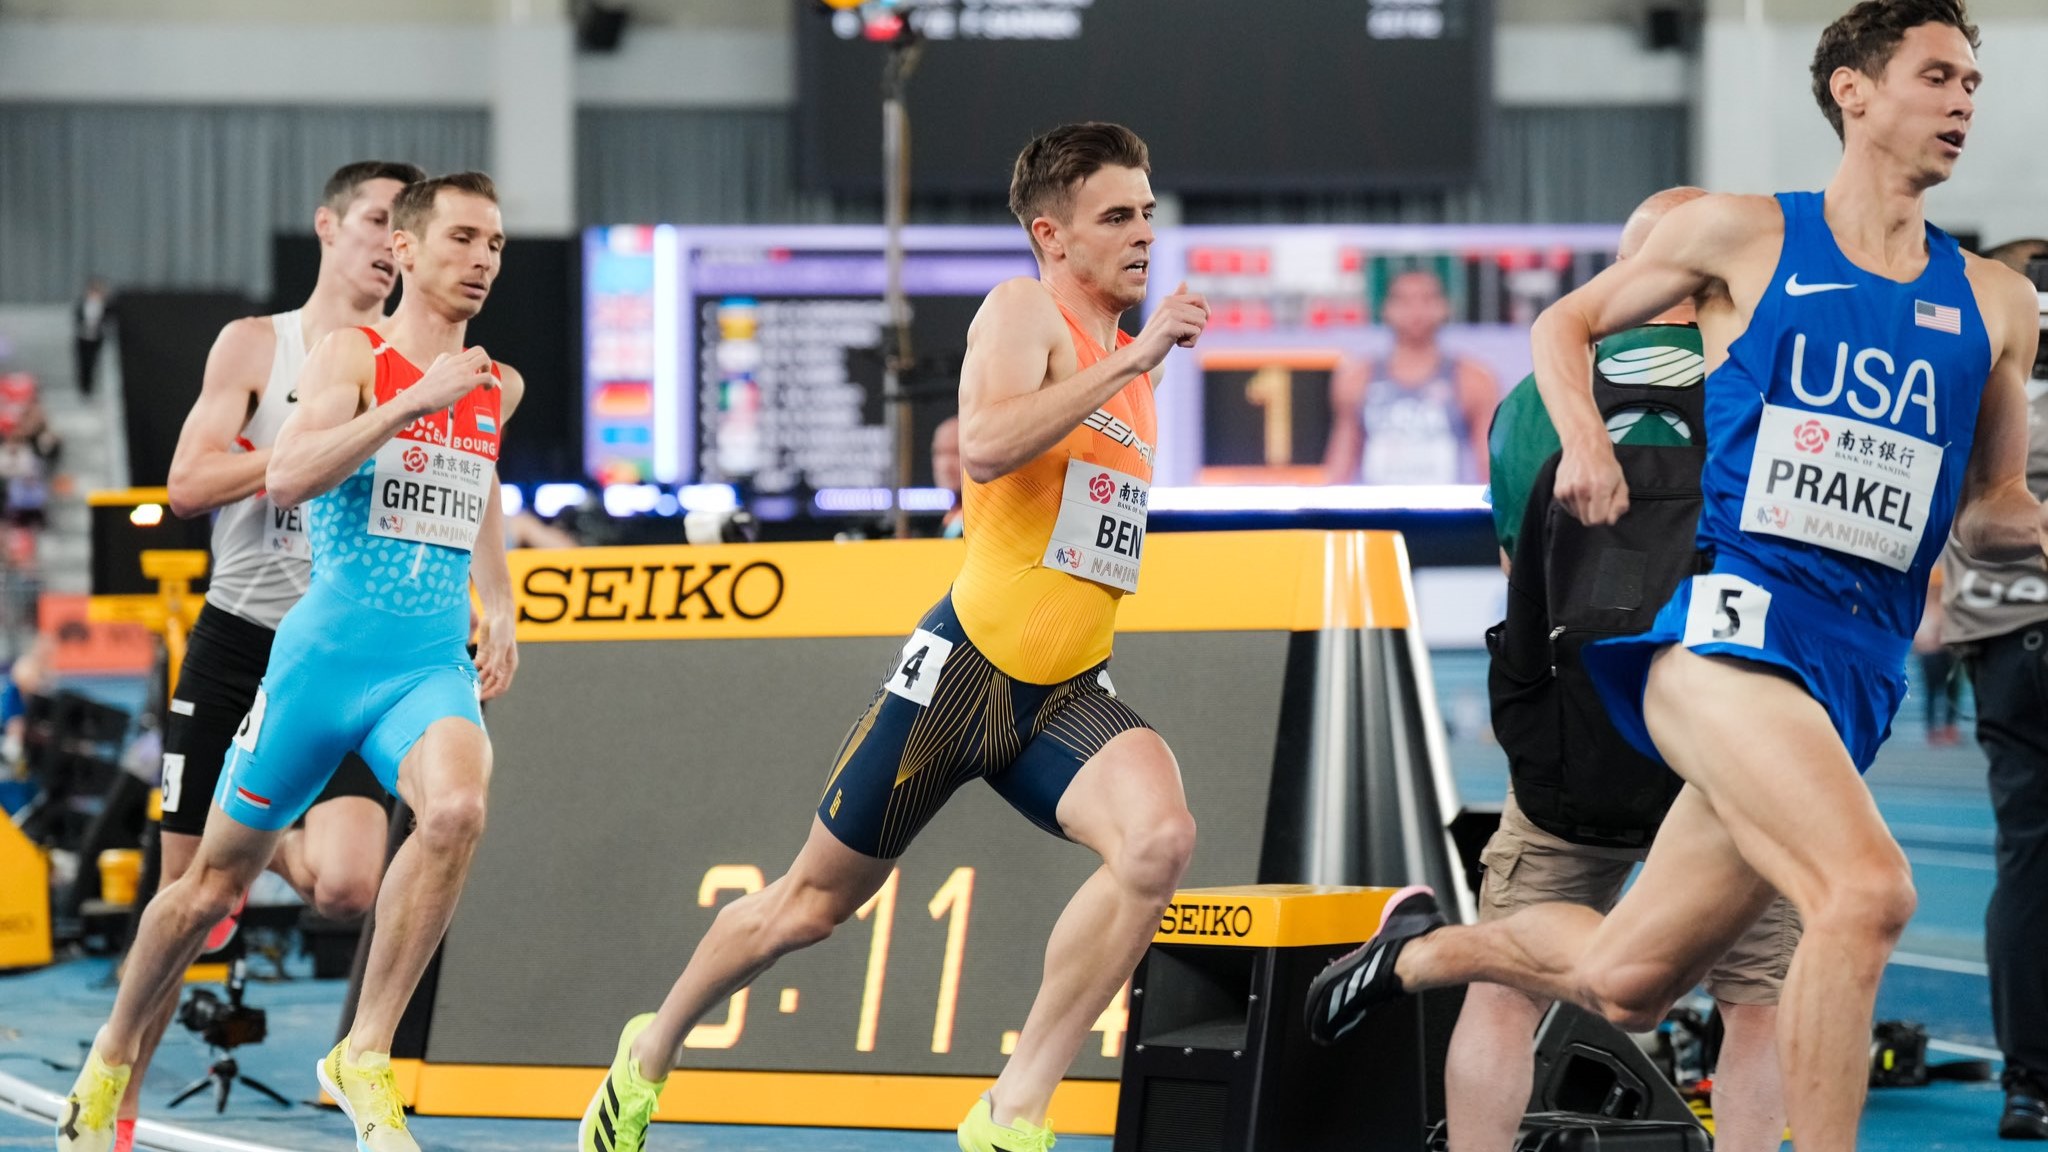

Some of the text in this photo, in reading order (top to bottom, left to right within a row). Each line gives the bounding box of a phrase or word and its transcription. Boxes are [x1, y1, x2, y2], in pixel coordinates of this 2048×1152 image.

[1791, 333, 1936, 435] USA
[433, 453, 481, 479] 南京银行
[1835, 451, 1859, 463] BANK
[1837, 429, 1915, 469] 南京银行
[383, 479, 485, 524] GRETHEN
[1119, 482, 1148, 507] 南京银
[1766, 459, 1913, 531] PRAKEL
[1095, 515, 1143, 560] BEN
[1803, 516, 1908, 561] NANJING 25
[519, 561, 784, 623] SEIKO
[1091, 557, 1138, 585] NANJIN
[1712, 589, 1743, 639] 5
[901, 646, 929, 690] 4
[1159, 904, 1252, 937] SEIKO
